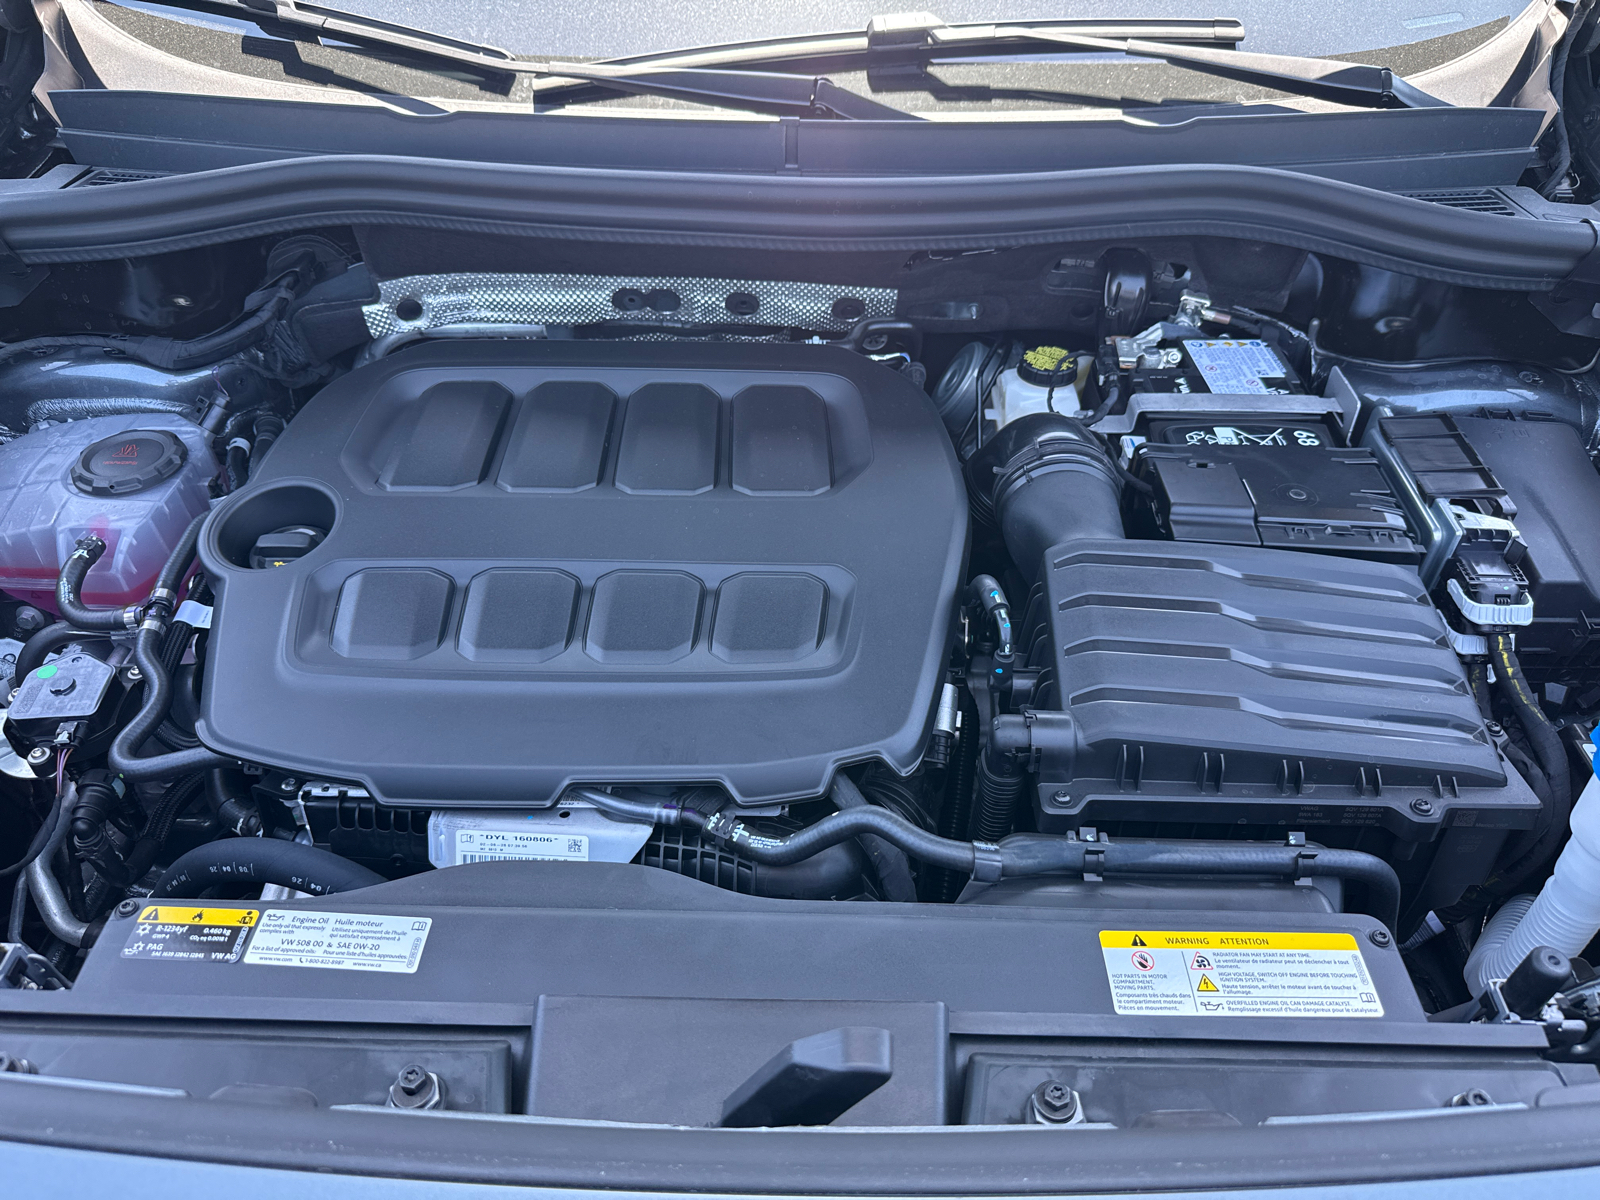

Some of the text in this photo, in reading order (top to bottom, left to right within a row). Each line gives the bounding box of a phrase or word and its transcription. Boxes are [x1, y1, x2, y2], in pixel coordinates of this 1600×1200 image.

[292, 916, 317, 924] Engine
[334, 918, 355, 926] Huile
[156, 925, 189, 934] R-1234yf
[222, 928, 231, 936] kg
[1165, 937, 1209, 945] WARNING
[353, 943, 380, 951] 0W-20
